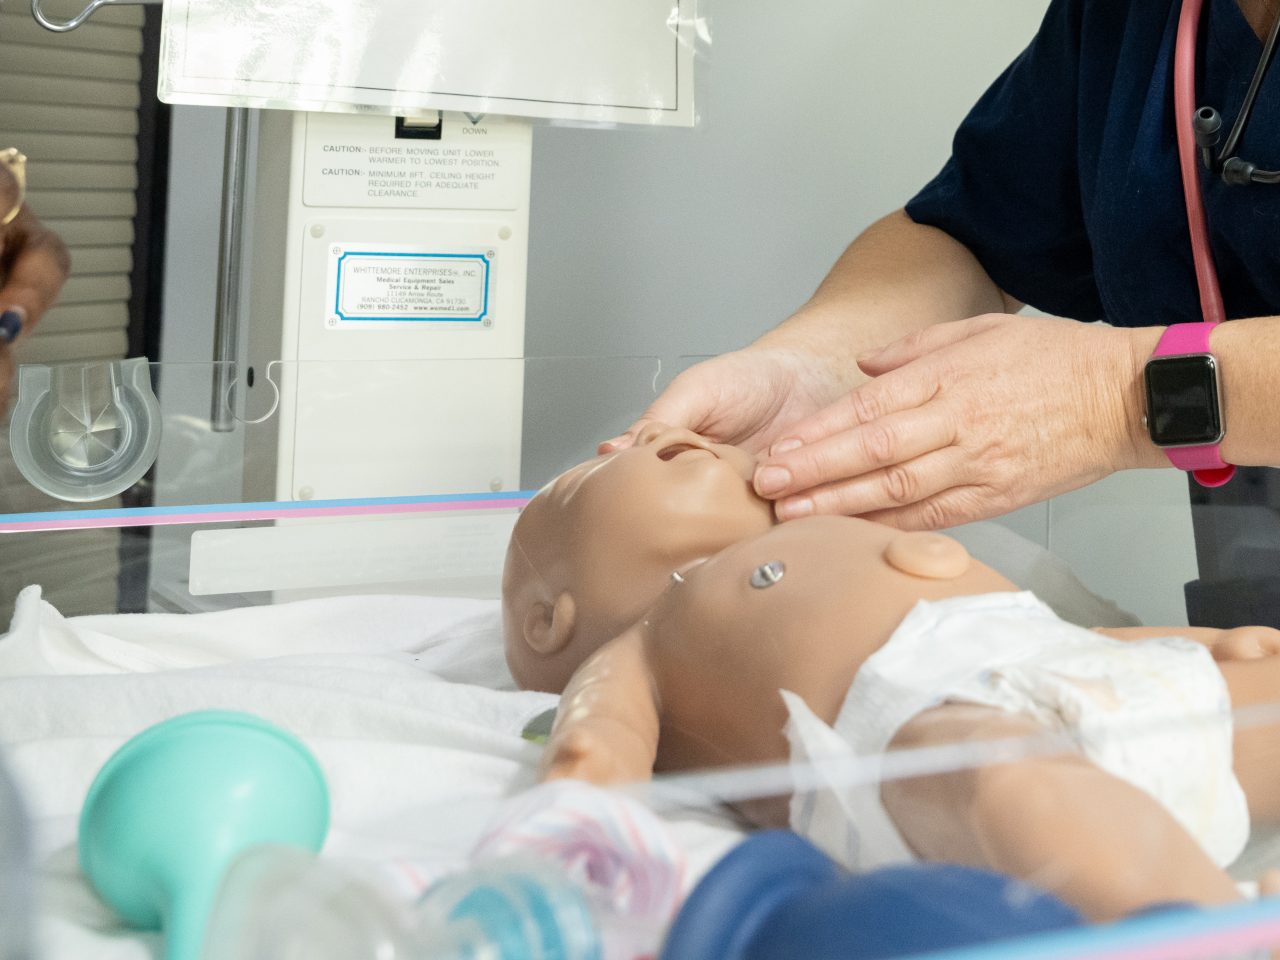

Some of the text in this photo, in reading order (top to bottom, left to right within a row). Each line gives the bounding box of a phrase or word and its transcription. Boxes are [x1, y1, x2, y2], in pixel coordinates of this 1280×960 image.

[462, 127, 488, 135] DOWN
[406, 148, 439, 156] MOVING
[369, 156, 406, 164] WARMER
[424, 158, 458, 166] LOWEST
[368, 170, 406, 178] MINIMUM
[465, 172, 495, 180] HEIGHT
[368, 179, 412, 188] REQUIRED
[435, 181, 479, 189] ADEQUATE
[354, 266, 401, 275] WHITTEMORE
